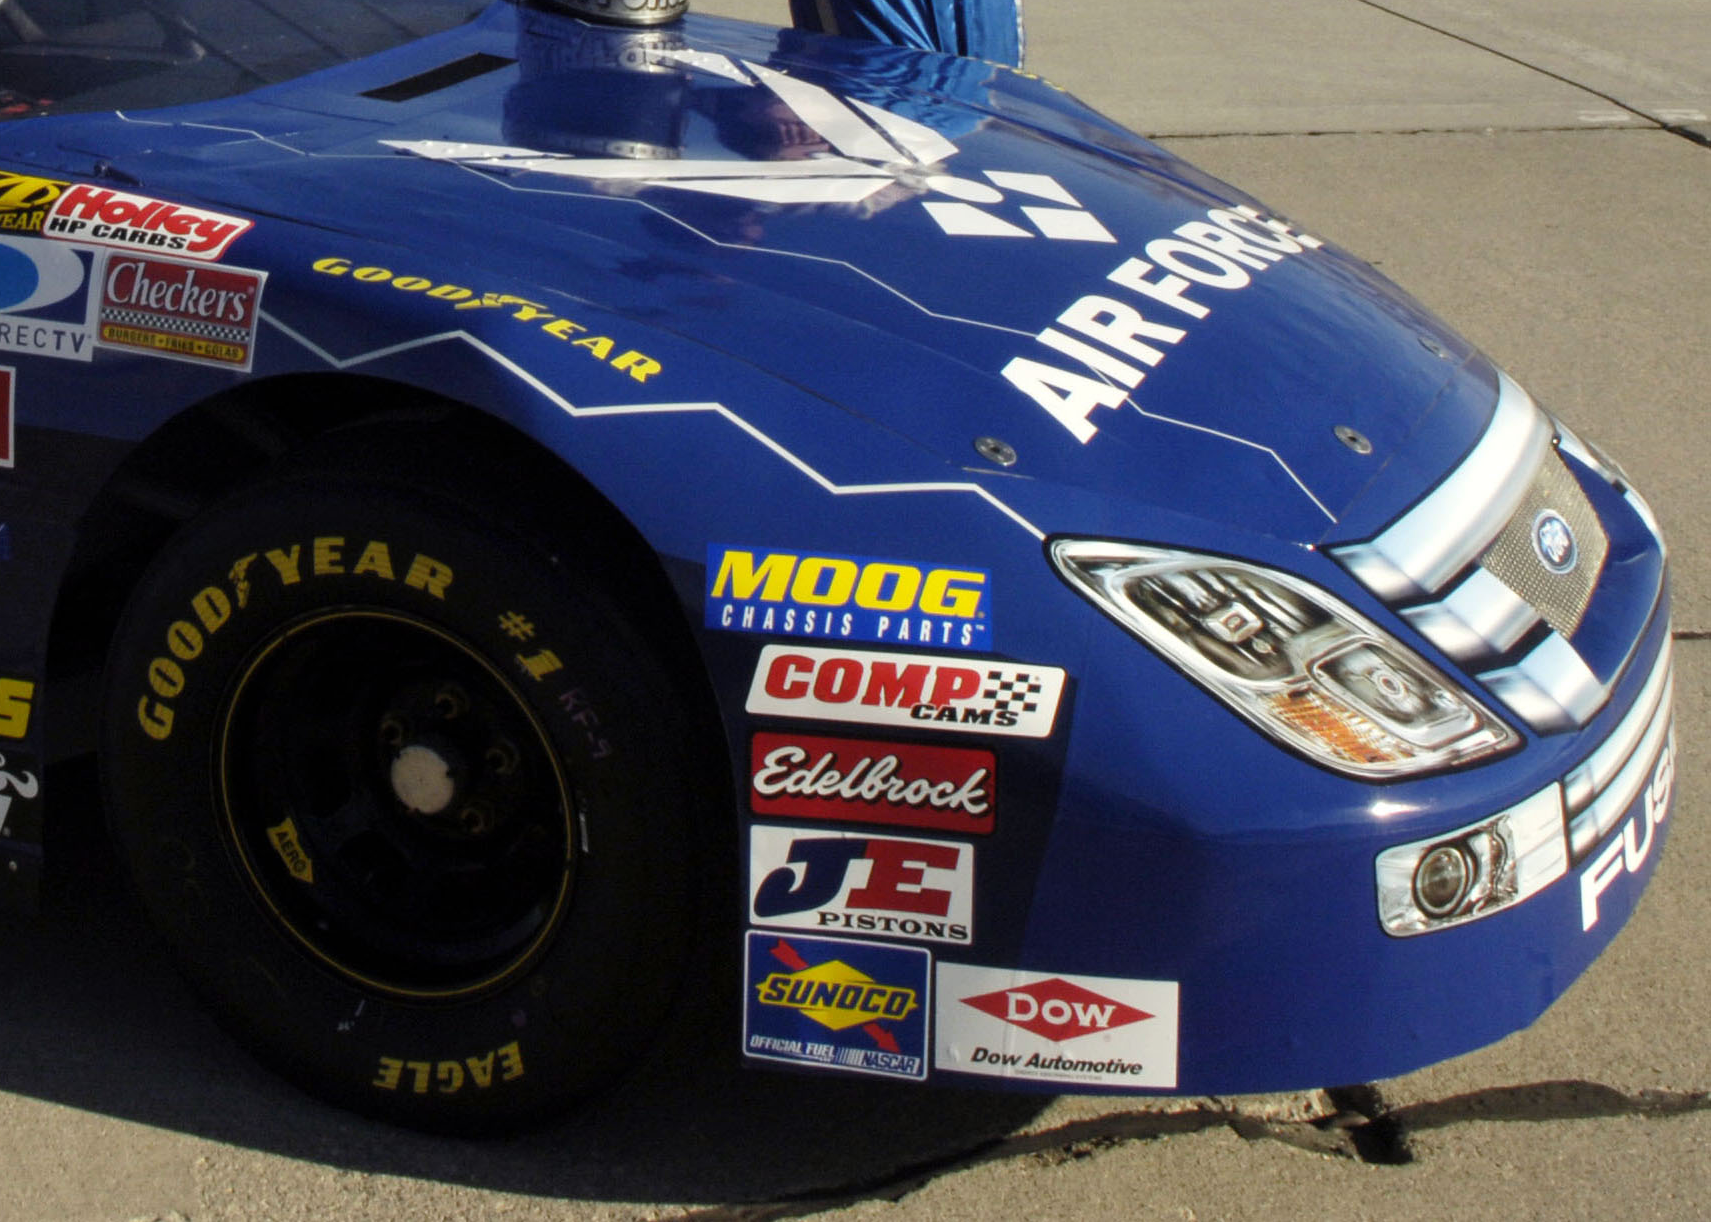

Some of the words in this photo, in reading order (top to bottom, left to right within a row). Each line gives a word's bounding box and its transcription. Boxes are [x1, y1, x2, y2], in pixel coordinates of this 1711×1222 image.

[48, 217, 86, 236] HP
[90, 222, 188, 251] CARBS
[51, 184, 238, 254] Holley
[105, 260, 249, 322] Checkers
[311, 256, 663, 384] GOODYEAR
[1000, 292, 1188, 445] AIR
[1106, 203, 1323, 320] FORCE
[710, 550, 986, 619] MOOG
[137, 536, 454, 740] GOODYEAR
[498, 610, 564, 681] #1
[721, 605, 853, 636] CHASSIS
[877, 617, 974, 646] PARTS
[764, 654, 981, 708] COMP
[910, 703, 1019, 728] CAMS
[752, 745, 991, 816] Edelbrock
[753, 837, 961, 918] JE
[817, 910, 969, 941] PISTONS
[763, 977, 911, 1018] SUNOCO
[372, 1041, 526, 1094] EAGLE
[750, 1034, 802, 1055] OFFICIAL
[805, 1042, 835, 1058] FUEL
[861, 1049, 917, 1075] NASCAR
[971, 1046, 1021, 1066] Dow
[1024, 1052, 1143, 1075] Automotive
